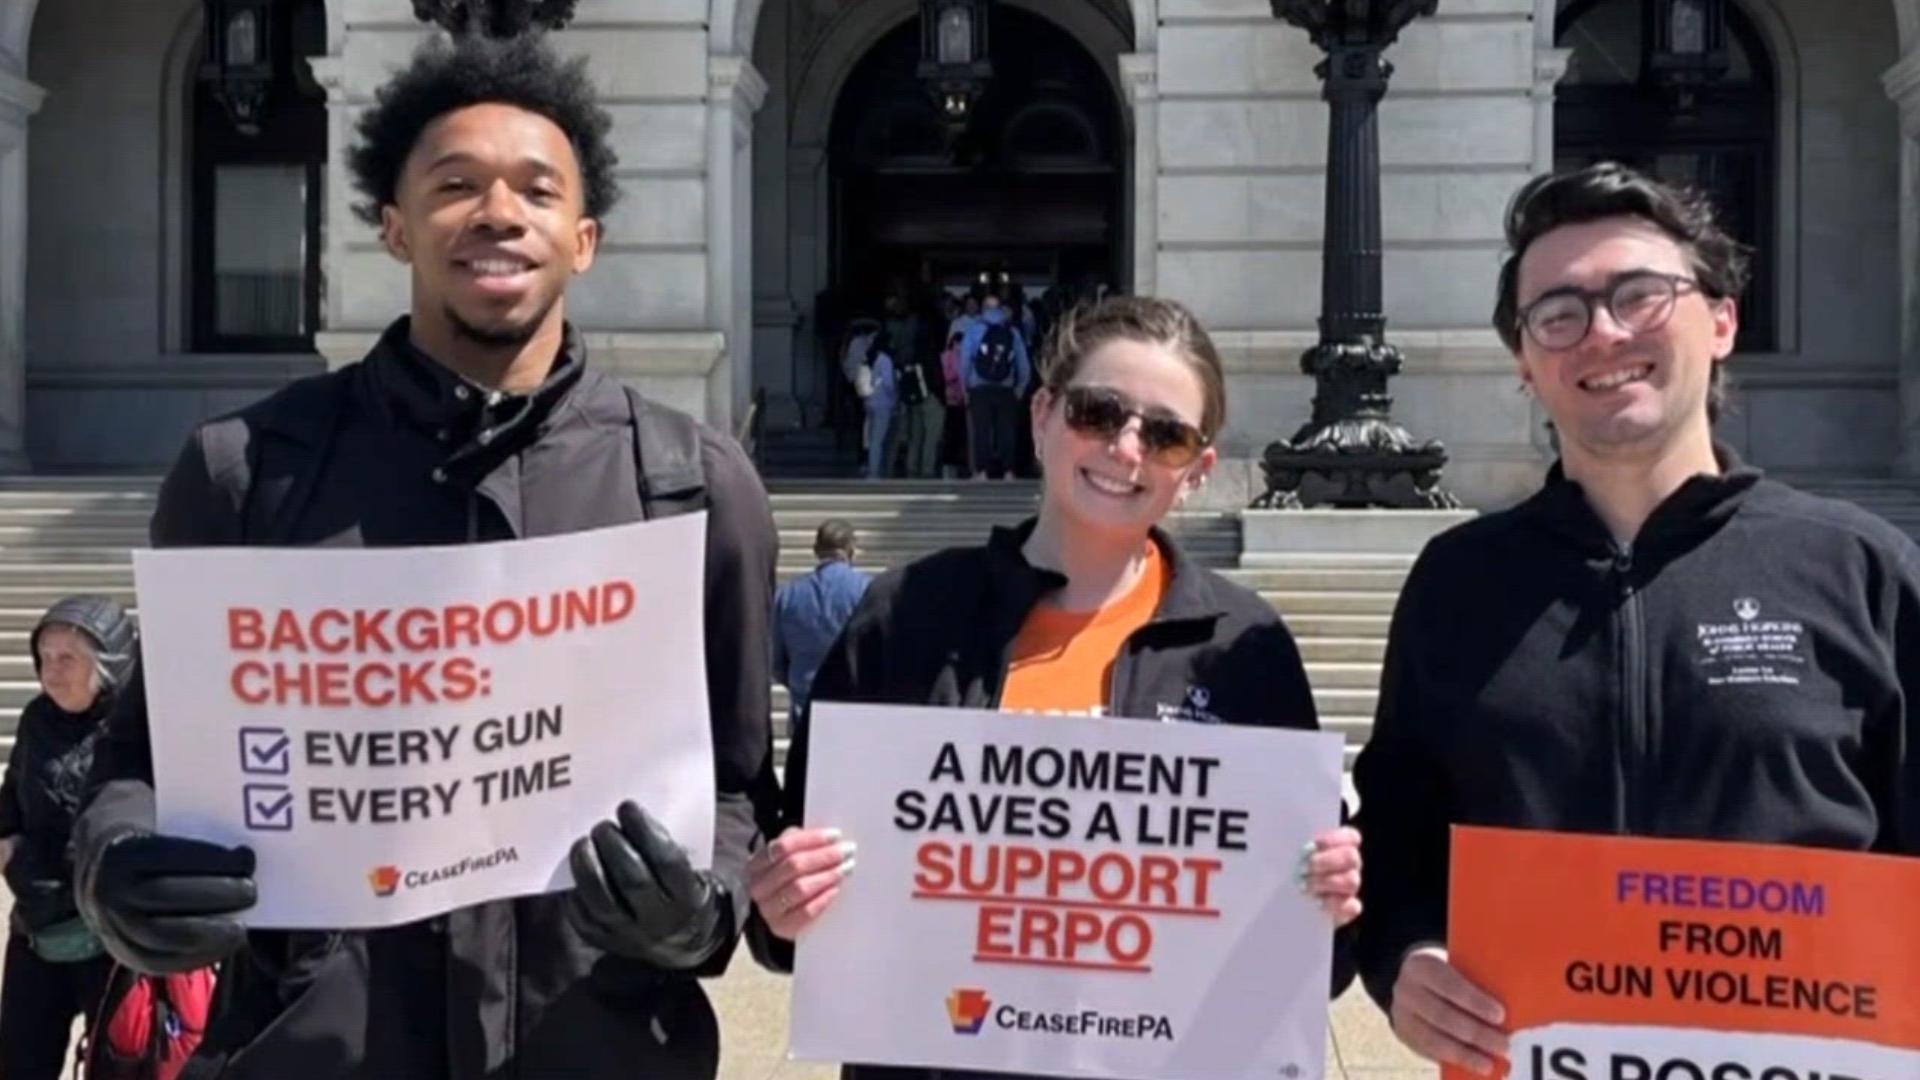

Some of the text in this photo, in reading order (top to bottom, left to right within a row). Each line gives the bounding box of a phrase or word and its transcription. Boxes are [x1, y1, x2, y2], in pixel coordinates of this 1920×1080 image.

[228, 580, 637, 653] BACKGROUND
[230, 658, 493, 707] CHECKS:
[305, 705, 565, 768] EVERY GUN
[308, 754, 573, 824] EVERY TIME
[929, 742, 1221, 798] A MOMENT
[893, 790, 1250, 851] SAVES A LIFE
[914, 842, 1222, 908] SUPPORT
[1616, 872, 1825, 916] FREEDOM
[976, 905, 1153, 963] ERPO
[1659, 920, 1783, 960] FROM
[1564, 960, 1877, 1019] GUN VIOLENCE
